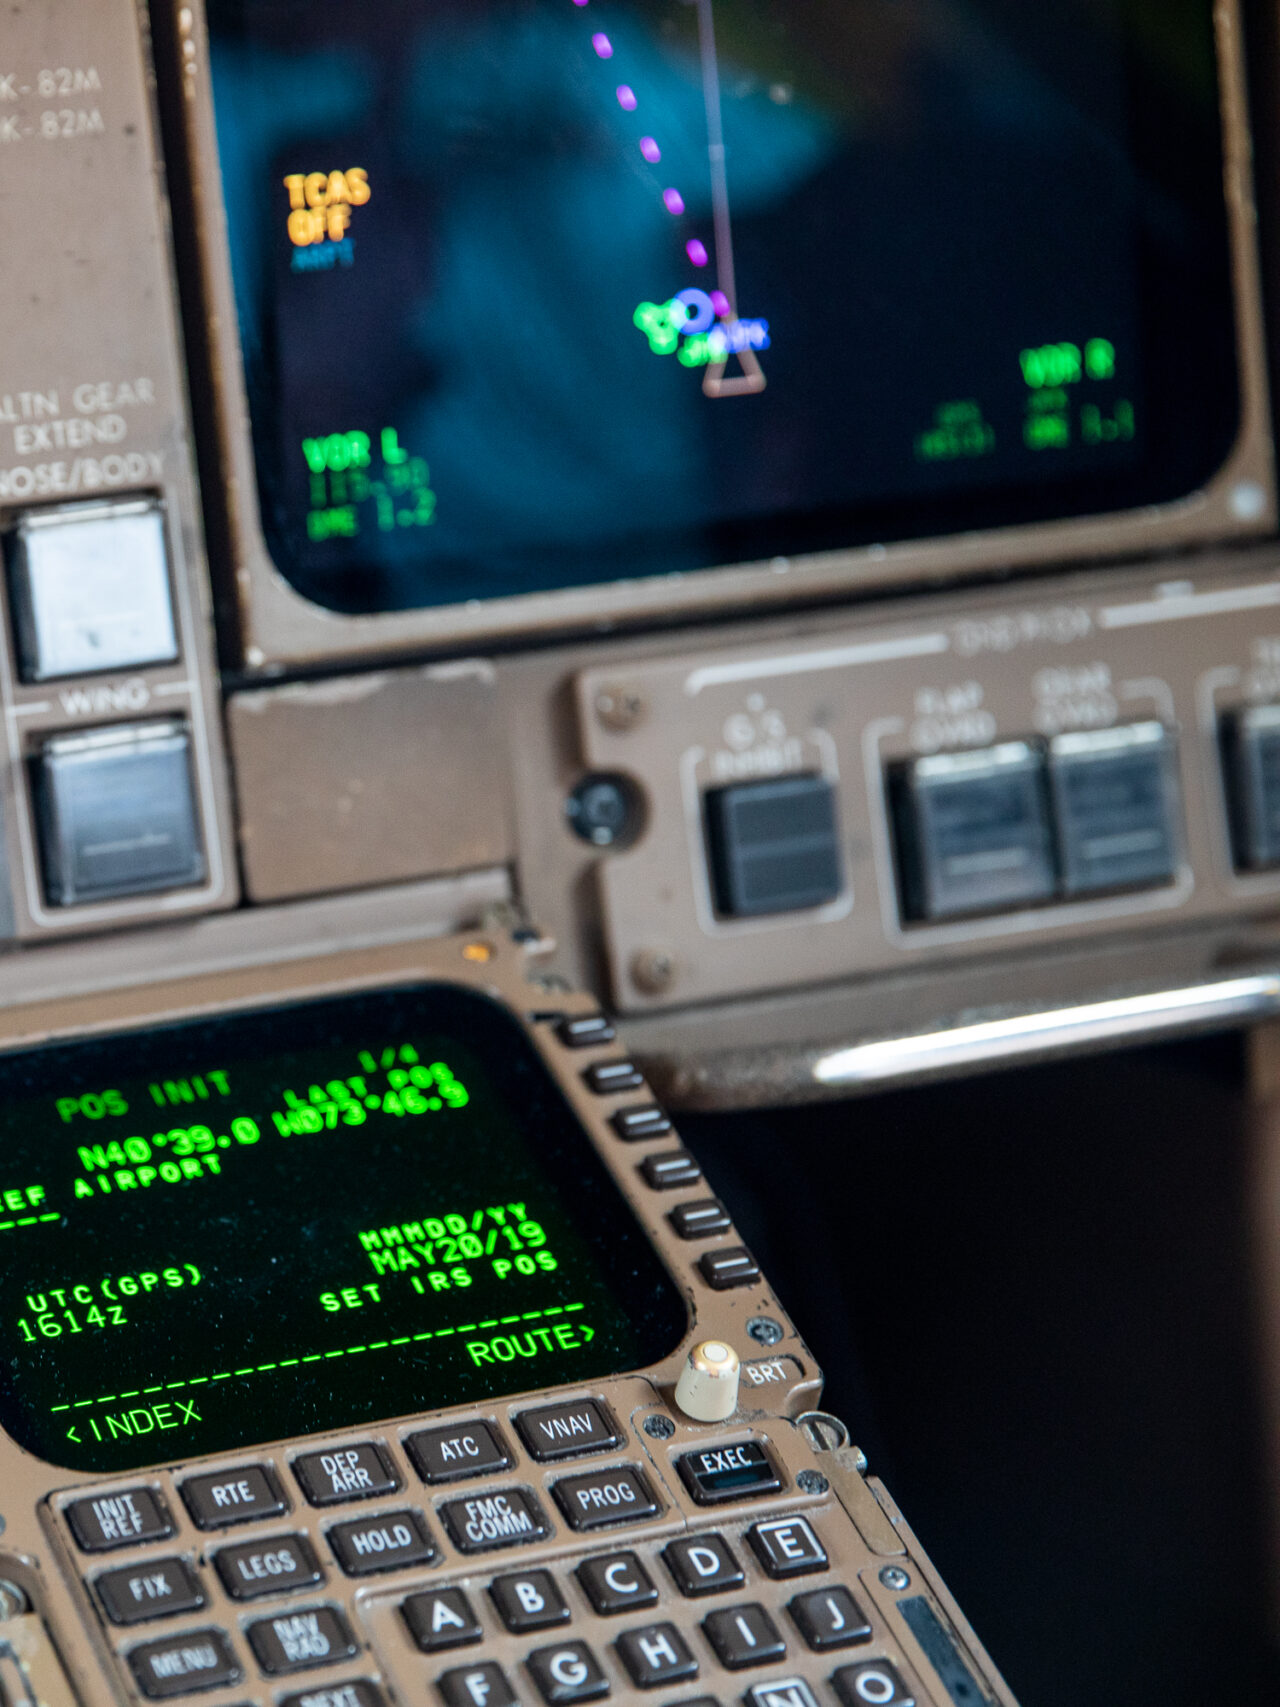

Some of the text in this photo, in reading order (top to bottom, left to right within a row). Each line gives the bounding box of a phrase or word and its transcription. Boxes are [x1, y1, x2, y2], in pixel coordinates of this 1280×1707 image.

[283, 167, 372, 210] TCAS
[72, 377, 156, 416] GEAR
[14, 414, 128, 456] EXTEND
[55, 1069, 232, 1123] POS INIT
[73, 1152, 222, 1199] AIRPORT
[357, 1201, 528, 1252] MMMDD/YY
[368, 1219, 548, 1276] MAY20/19
[25, 1262, 202, 1314] UTC(GPS)
[319, 1249, 559, 1313] SET IRS POS
[745, 1360, 788, 1386] BRT
[538, 1412, 595, 1441] VNAV
[319, 1450, 360, 1476] DEP
[439, 1435, 480, 1462] ATC
[699, 1444, 753, 1475] EXEC
[210, 1480, 256, 1508] RTE
[330, 1468, 374, 1494] ARR
[574, 1480, 637, 1511] PROG
[92, 1493, 136, 1520] INIT
[463, 1495, 513, 1521] FMC
[98, 1513, 144, 1540] REF
[351, 1524, 413, 1556] HOLD
[464, 1510, 534, 1543] COMM
[773, 1528, 805, 1559] E
[236, 1550, 297, 1581] LEGS
[604, 1561, 639, 1594] C
[687, 1546, 720, 1578] D
[128, 1573, 172, 1602] FIX
[514, 1580, 546, 1614] B
[431, 1599, 465, 1633] A
[825, 1597, 845, 1631] J
[734, 1615, 757, 1647] I
[149, 1644, 220, 1680] MENU
[638, 1631, 679, 1669] H
[549, 1650, 589, 1687] G
[464, 1672, 490, 1707] F
[766, 1684, 800, 1707] N
[854, 1669, 896, 1705] O
